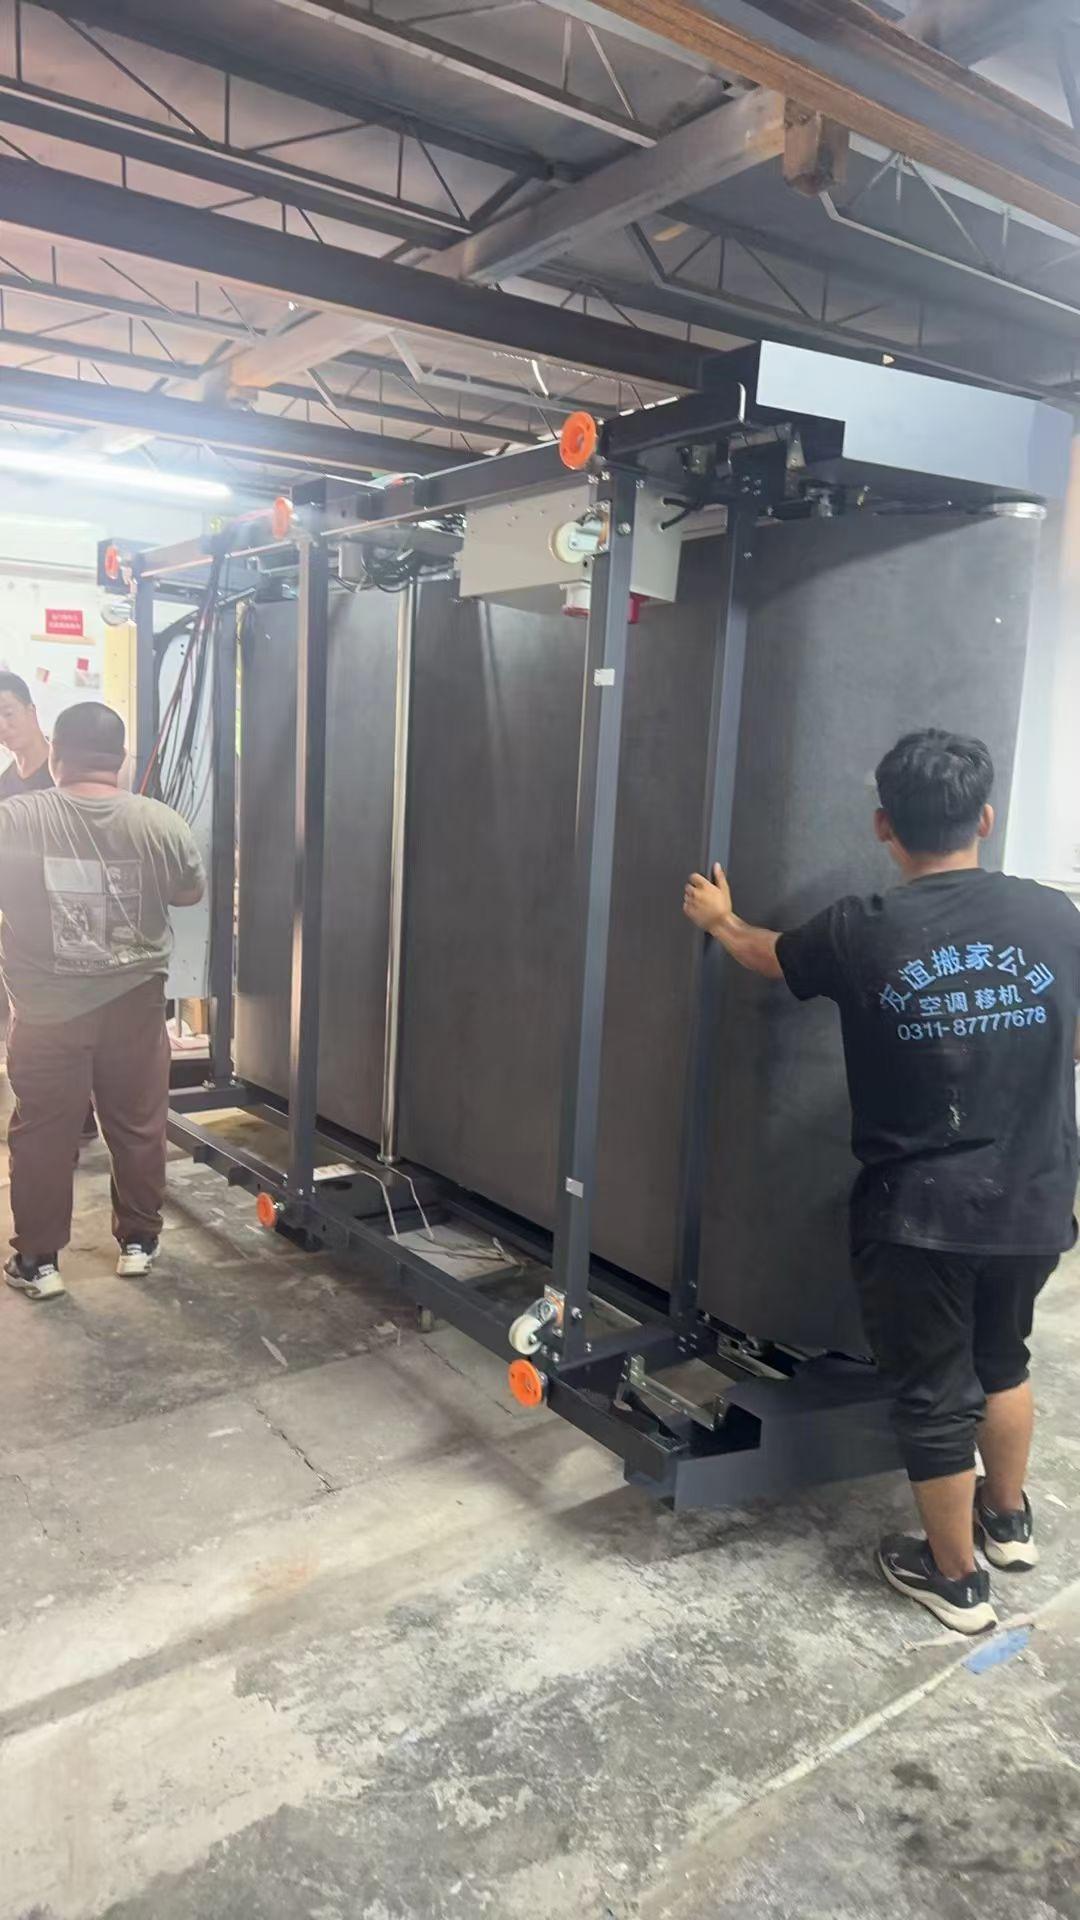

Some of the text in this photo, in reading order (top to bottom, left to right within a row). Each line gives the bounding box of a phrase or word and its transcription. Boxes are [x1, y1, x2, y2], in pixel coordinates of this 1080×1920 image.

[879, 941, 1055, 1013] 友谊搬家公司
[897, 1006, 1047, 1041] 0311-87777678
